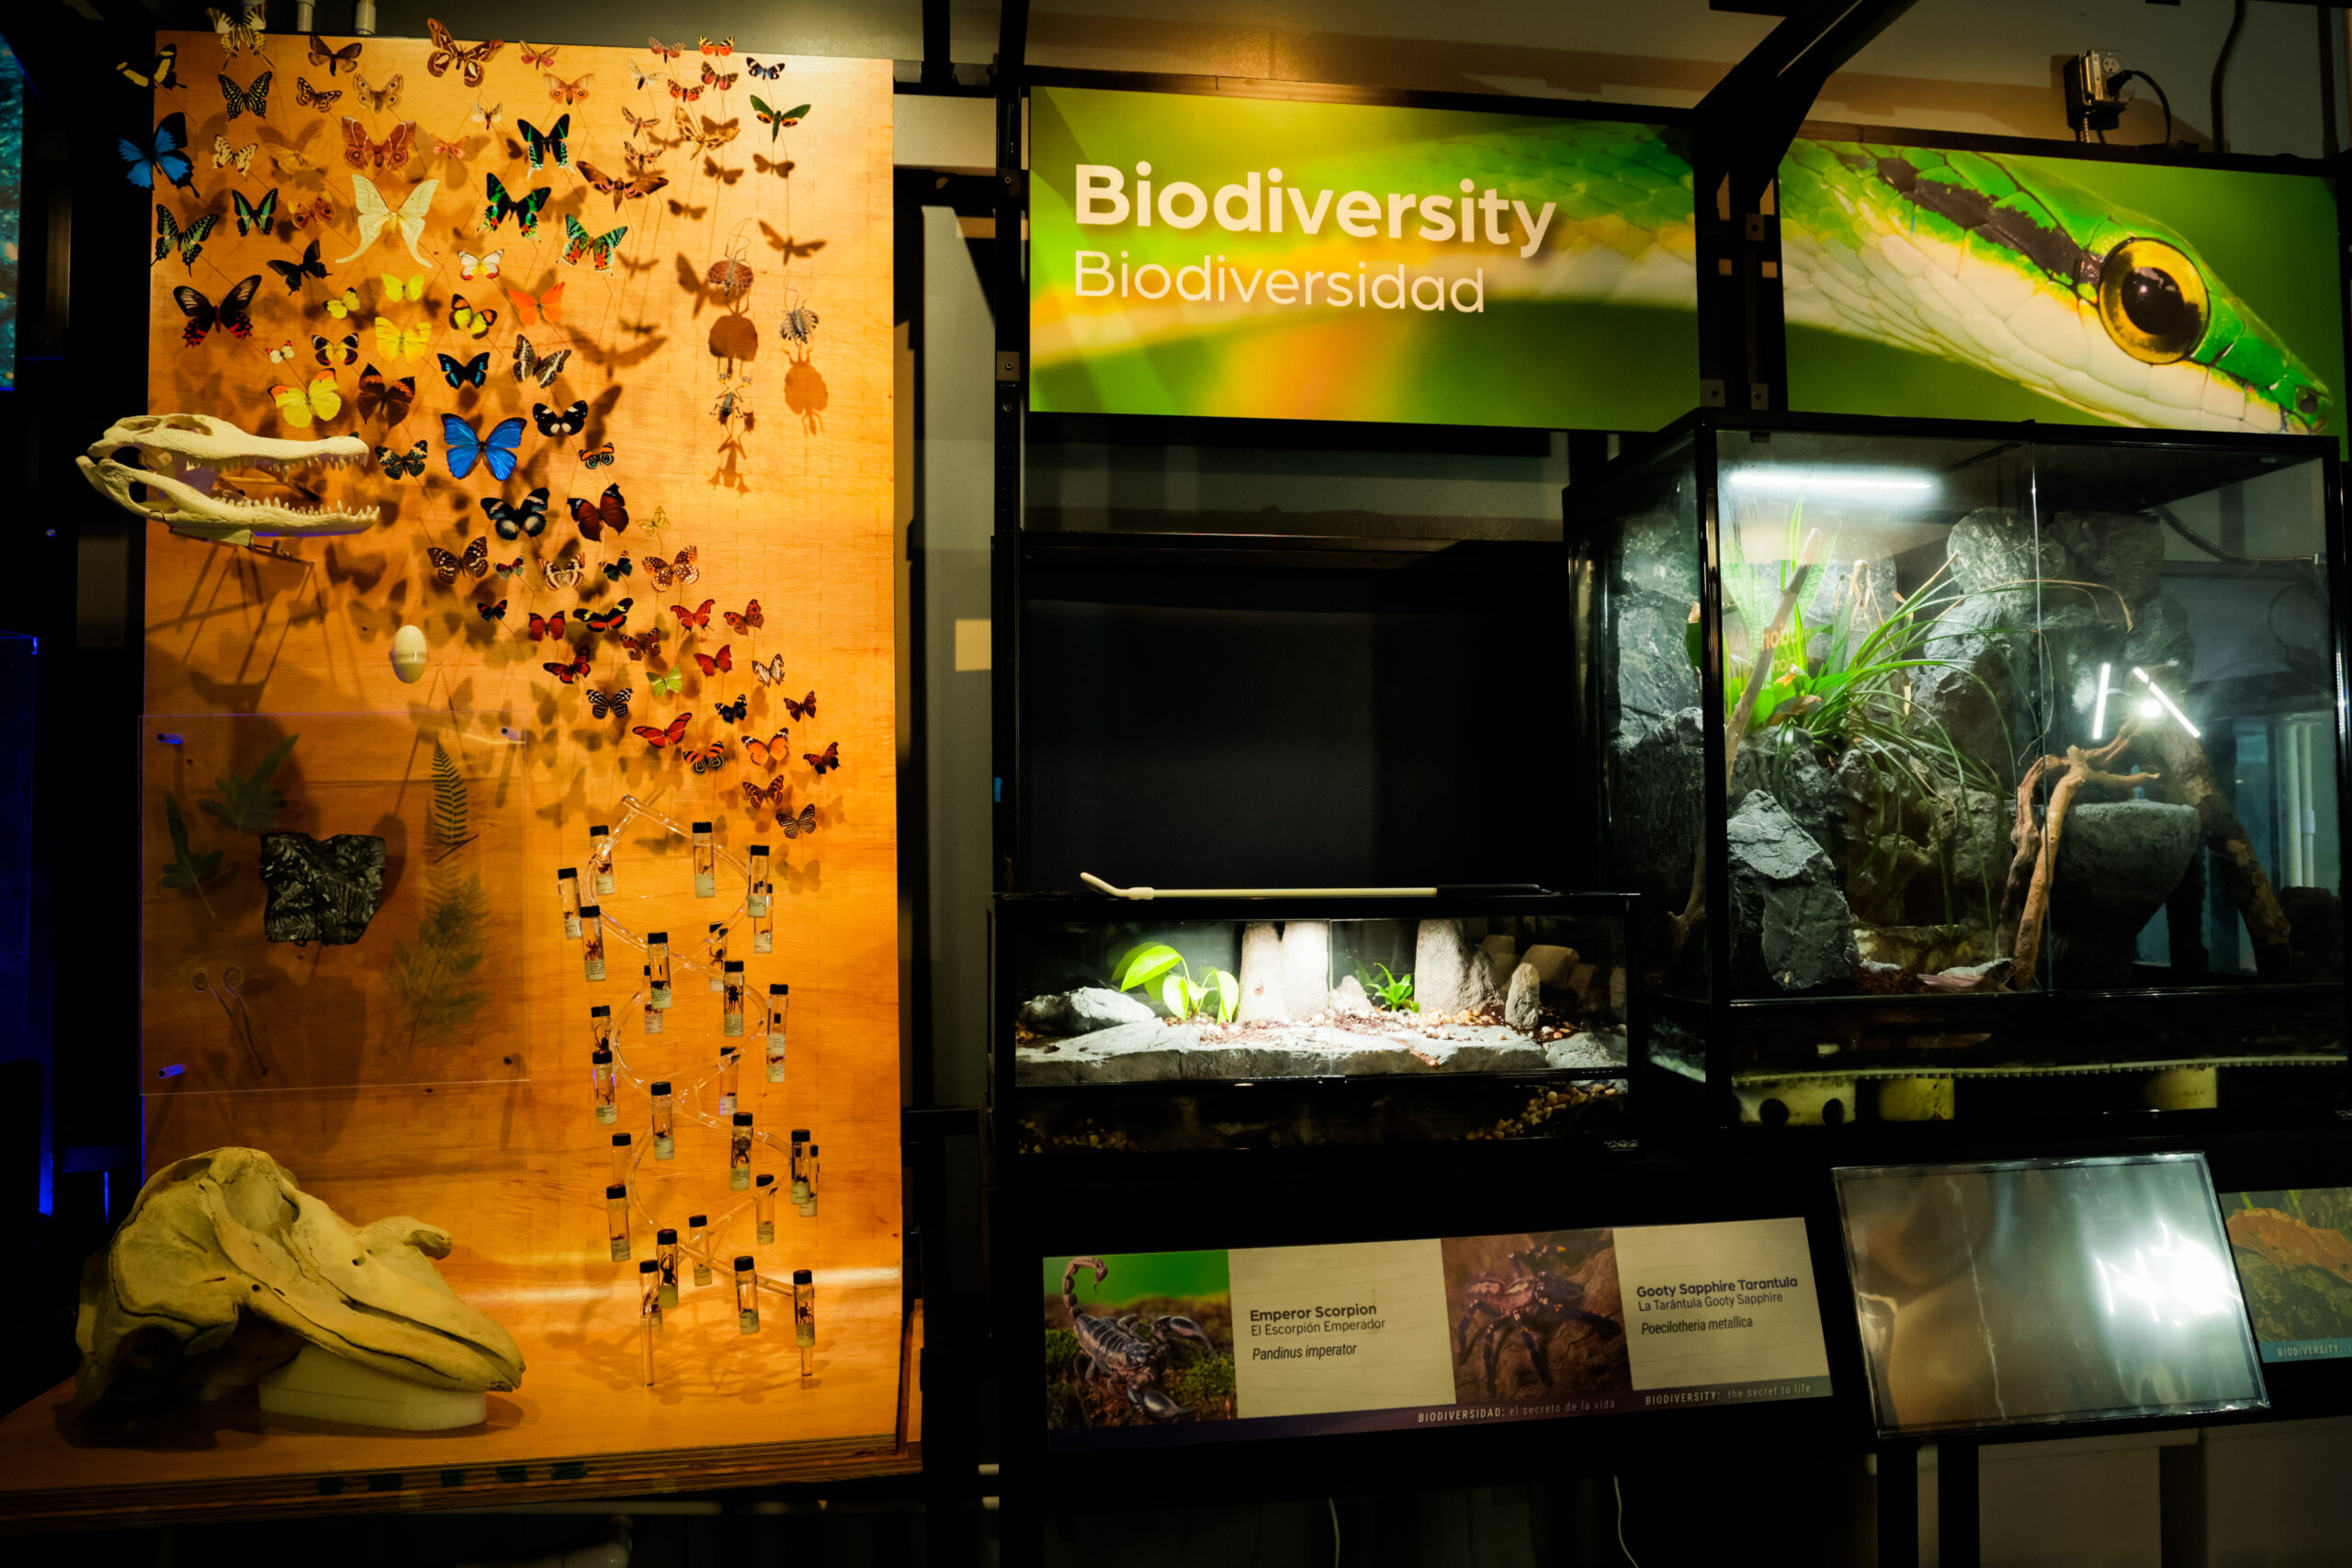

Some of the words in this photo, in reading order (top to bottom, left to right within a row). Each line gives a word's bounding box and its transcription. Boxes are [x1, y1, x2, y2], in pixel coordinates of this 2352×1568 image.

[1075, 161, 1556, 257] Biodiversity
[1074, 249, 1485, 313] Biodiversidad
[1636, 1285, 1676, 1297] Gooty
[1679, 1281, 1736, 1295] Sapphire
[1737, 1277, 1798, 1290] Tarantula
[1638, 1302, 1651, 1312] La
[1654, 1297, 1702, 1310] Tarántula
[1705, 1297, 1735, 1308] Gooty
[1737, 1293, 1783, 1306] Sapphire
[1250, 1309, 1311, 1323] Emperor
[1316, 1305, 1377, 1318] Scorpion
[1251, 1325, 1261, 1336] El
[1264, 1323, 1321, 1336] Escorpión
[1324, 1319, 1385, 1333] Emperador
[1642, 1321, 1706, 1334] Poecilotheria
[1708, 1317, 1753, 1329] metallica
[1252, 1347, 1303, 1360] Pandinus
[1305, 1344, 1357, 1359] imperator
[2278, 1345, 2343, 1357] BIODIVERSITY:
[1645, 1391, 1721, 1405] BIODIVERSITY:
[1728, 1389, 1744, 1399] the
[1747, 1386, 1778, 1397] secret
[1781, 1385, 1791, 1395] to
[1794, 1383, 1811, 1393] life
[1418, 1408, 1505, 1424] BIODIVERSIDAD:
[1509, 1406, 1519, 1416] el
[1523, 1404, 1562, 1415] secreto
[1566, 1402, 1577, 1412] de
[1581, 1401, 1591, 1411] la
[1595, 1400, 1615, 1410] vida
